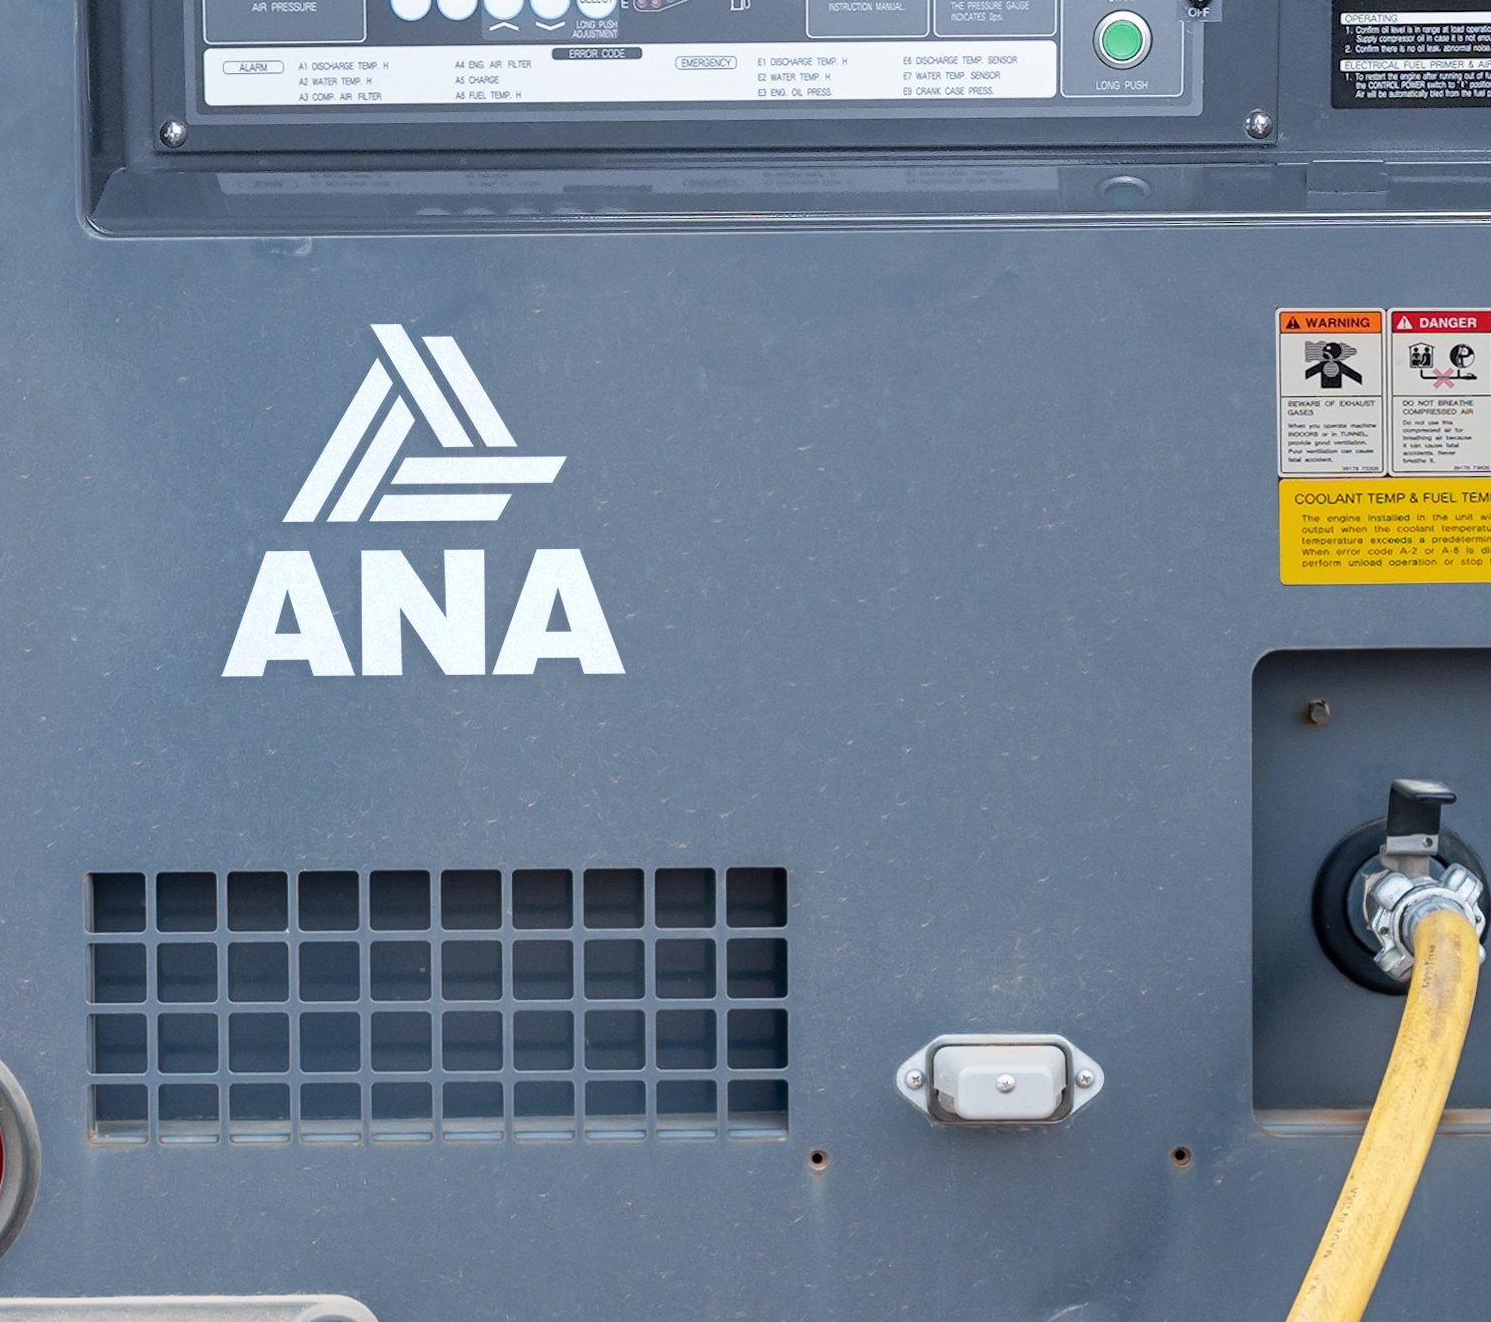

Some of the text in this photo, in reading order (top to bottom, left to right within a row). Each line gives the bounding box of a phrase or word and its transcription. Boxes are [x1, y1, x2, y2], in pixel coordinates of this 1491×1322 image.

[252, 2, 317, 11] AIR PRESSURE
[621, 0, 628, 8] E
[829, 1, 872, 11] INSTRUCTION
[968, 0, 1004, 11] PRESSURE
[1345, 14, 1398, 22] OPERATING
[576, 20, 618, 29] LONG PUSH
[572, 30, 618, 38] ADJUSTMENT
[569, 49, 626, 58] ERROR CODE
[681, 58, 731, 68] EMERGENCY
[916, 56, 958, 65] DISCHARGE
[988, 55, 1018, 65] SENSOR
[239, 63, 268, 72] ALARM
[312, 62, 354, 71] DISCHARGE
[1344, 61, 1399, 69] ELECTRICAL
[1404, 61, 1425, 69] FUEL
[903, 72, 912, 80] E7
[916, 71, 941, 80] WATER
[970, 71, 1000, 79] SENSOR
[1095, 79, 1148, 91] LONG PUSH
[1306, 317, 1370, 328] WARNING
[1420, 317, 1476, 328] DANGER
[1294, 493, 1363, 506] COOLANT
[1368, 493, 1406, 504] TEMP
[1410, 493, 1419, 503] &
[1423, 491, 1457, 503] FUEL
[1302, 515, 1320, 523] The
[1326, 515, 1360, 523] engine
[1302, 526, 1335, 534] output
[1341, 526, 1367, 534] when
[1397, 525, 1434, 533] coolant
[1302, 537, 1363, 545] temperature
[1370, 536, 1412, 545] exceeds
[1301, 548, 1330, 556] When
[1336, 548, 1361, 556] error
[1400, 546, 1417, 555] A-2
[1302, 559, 1341, 569] perform
[1348, 559, 1382, 567] unload
[1388, 559, 1437, 567] operation
[221, 548, 626, 677] ANA
